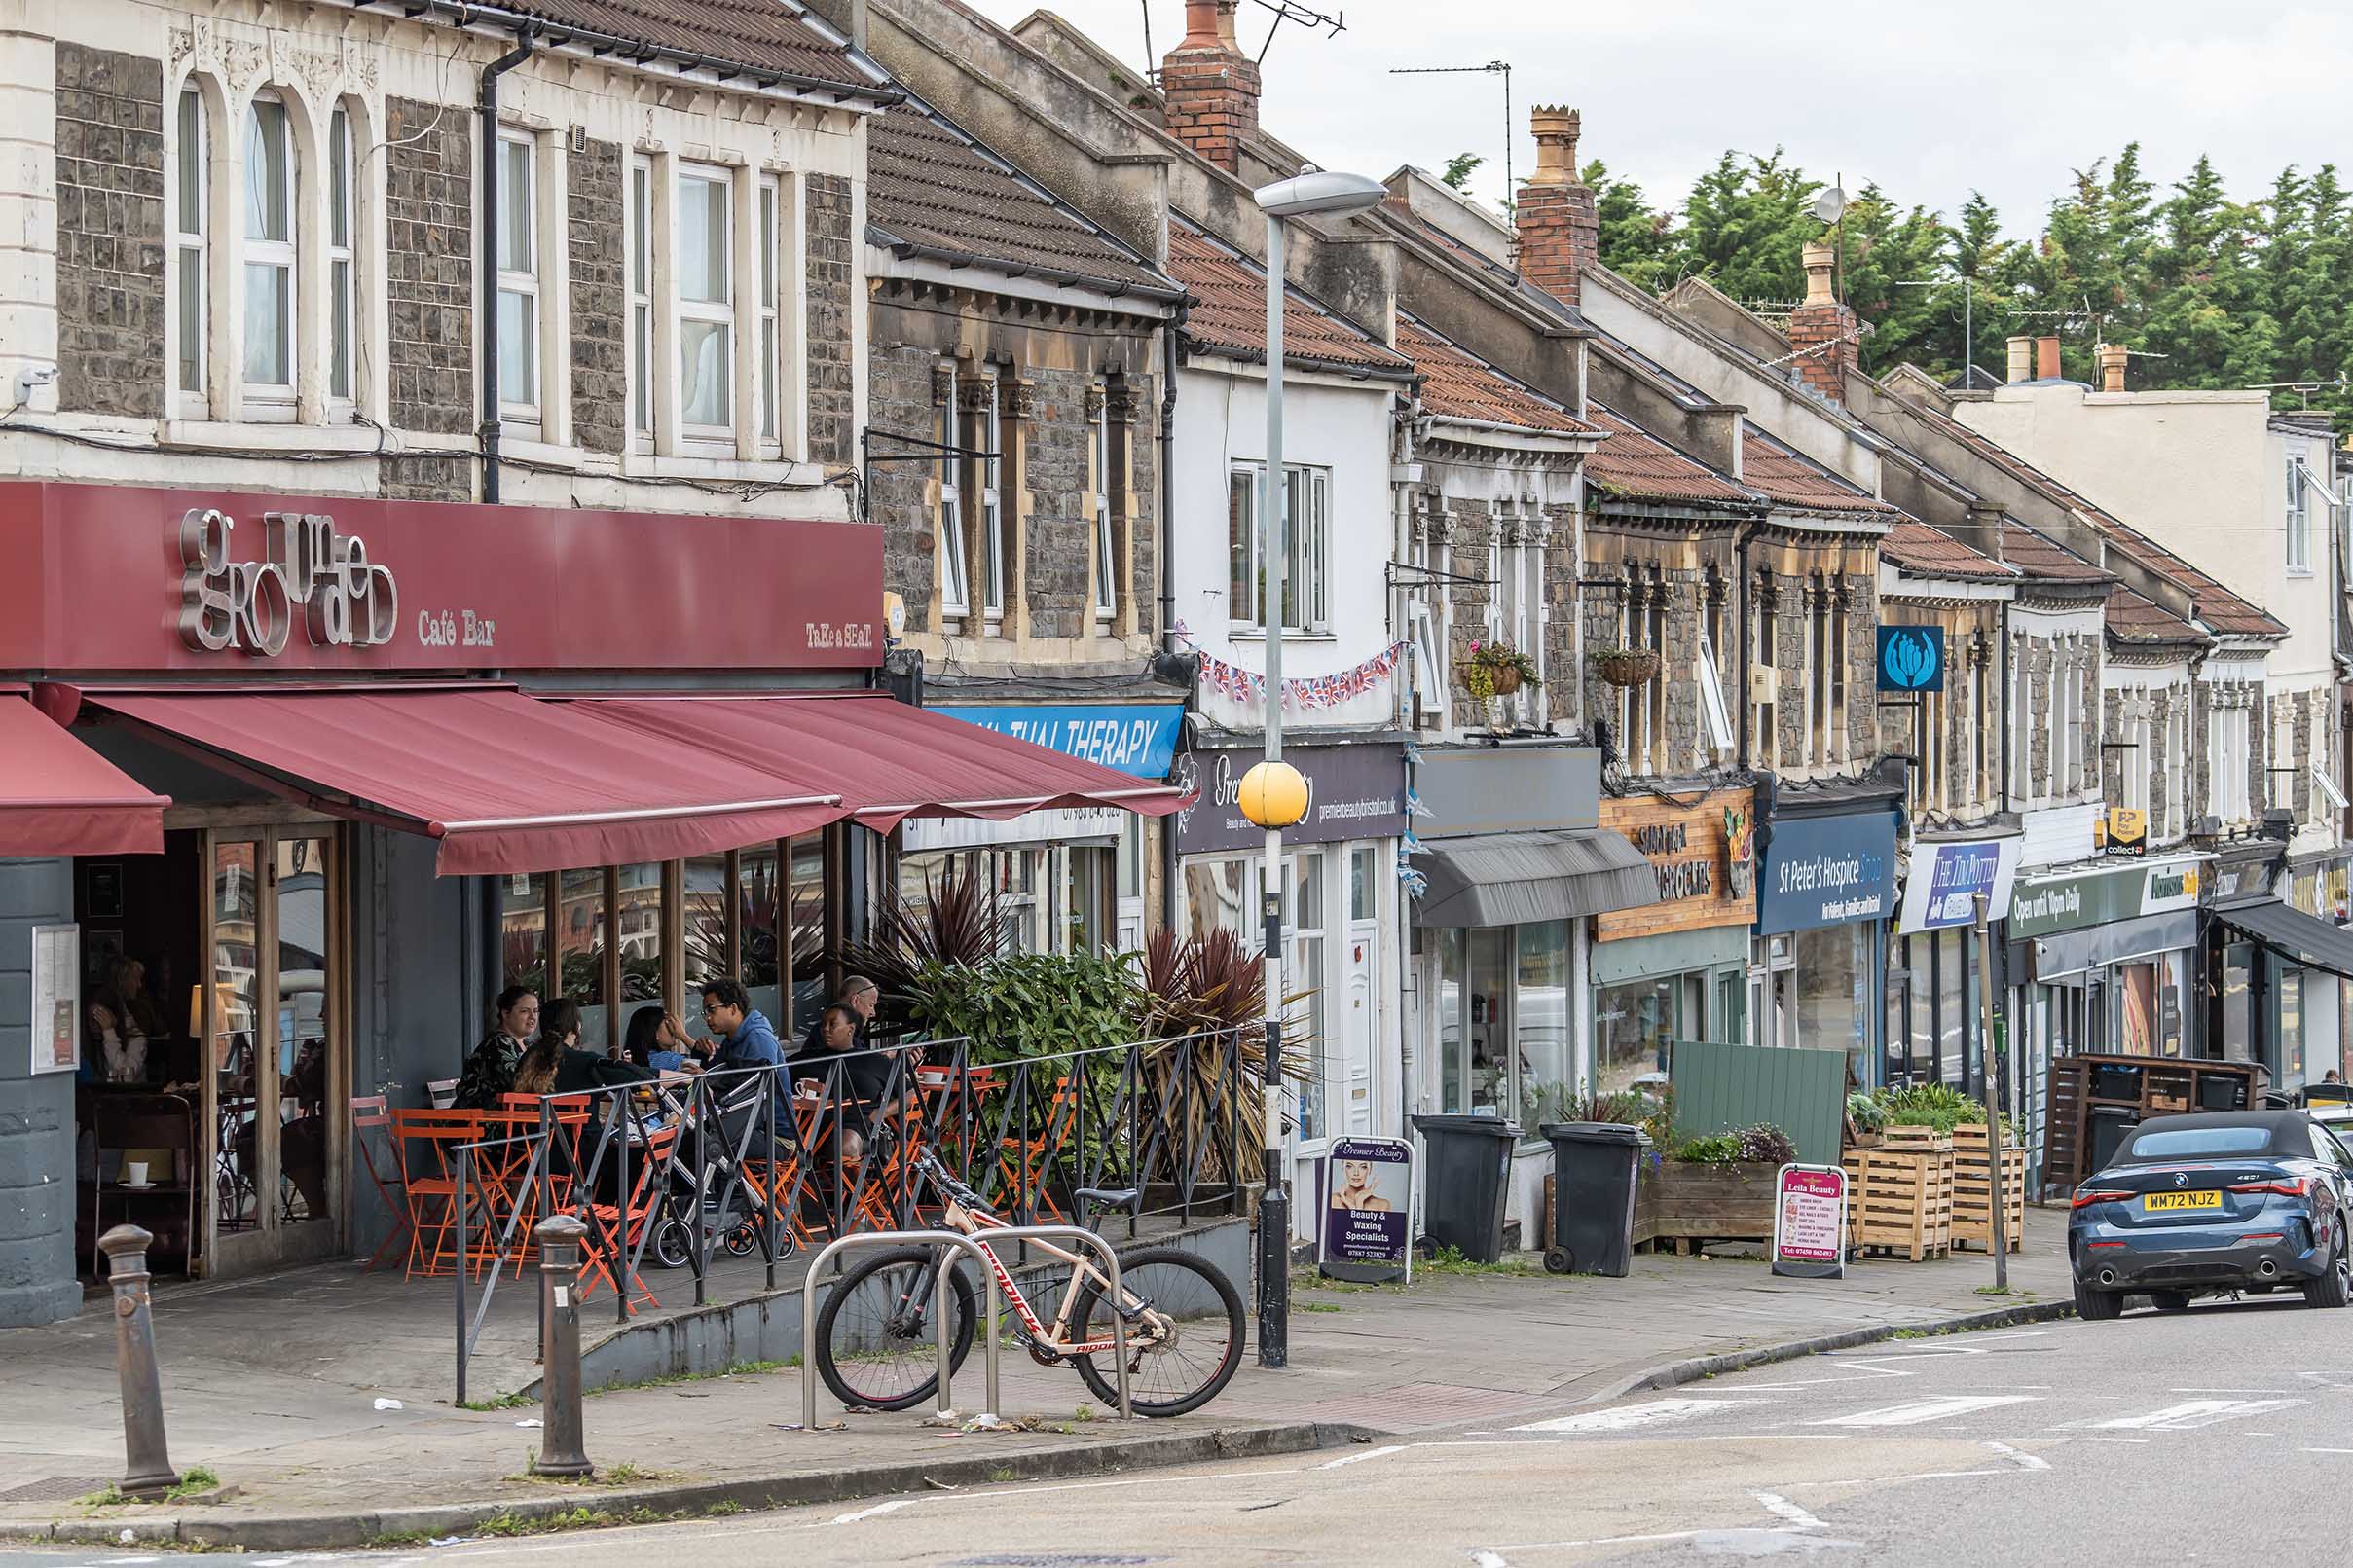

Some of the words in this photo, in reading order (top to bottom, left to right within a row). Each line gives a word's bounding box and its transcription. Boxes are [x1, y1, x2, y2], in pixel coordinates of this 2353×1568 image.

[419, 609, 456, 646] Café
[462, 610, 495, 646] Bar
[1066, 720, 1159, 765] THERAPY
[1319, 796, 1396, 824] premierbeautybristol.co.uk
[1779, 861, 1789, 893] St
[1791, 854, 1822, 892] Peter's
[1823, 852, 1858, 894] Hospice
[2151, 867, 2184, 900] Morrisons
[2014, 894, 2033, 928] Open
[2033, 888, 2048, 918] until
[2048, 889, 2065, 923] 10pm
[2065, 884, 2080, 918] Daily
[1343, 1144, 1374, 1156] Premier
[1374, 1146, 1403, 1162] Beauty
[1787, 1183, 1808, 1193] Leila
[1810, 1185, 1836, 1196] Beauty
[2151, 1194, 2186, 1208] WM72
[2188, 1192, 2215, 1206] NJZ
[1350, 1210, 1379, 1221] Beauty
[1379, 1212, 1386, 1221] &
[1353, 1221, 1382, 1232] Waxing
[1345, 1230, 1390, 1243] Specialists
[980, 1242, 1043, 1333] RIDDICK
[1075, 1340, 1130, 1353] RIDDI
